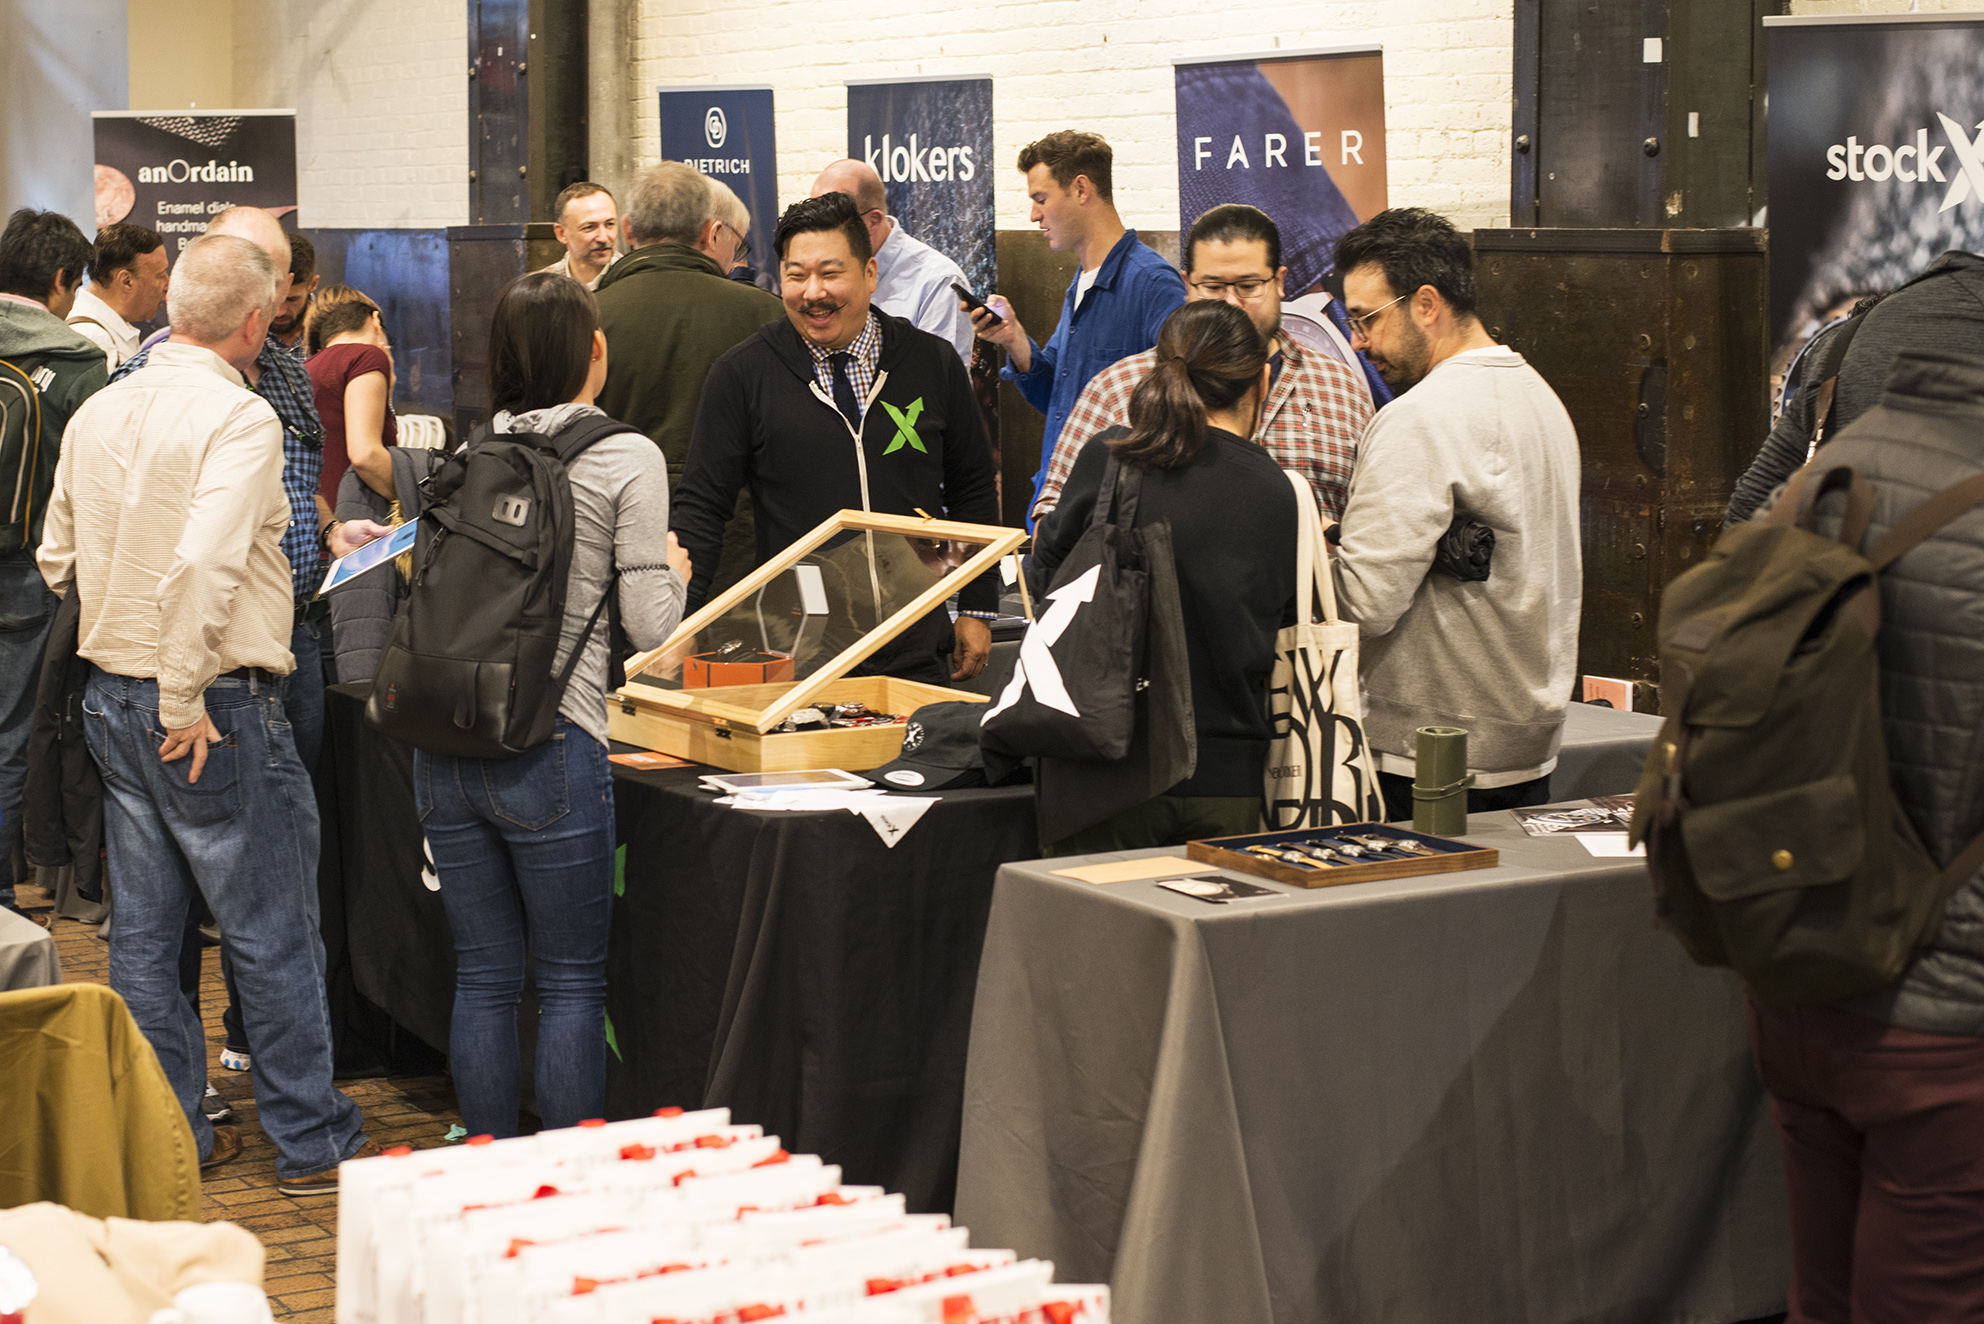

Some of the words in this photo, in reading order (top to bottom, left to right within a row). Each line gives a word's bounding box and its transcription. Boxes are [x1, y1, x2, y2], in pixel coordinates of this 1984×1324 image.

[864, 133, 975, 182] klokers
[1194, 130, 1364, 170] FARER
[138, 159, 254, 183] anOrdain
[157, 201, 205, 215] Enamel
[155, 219, 209, 233] handma
